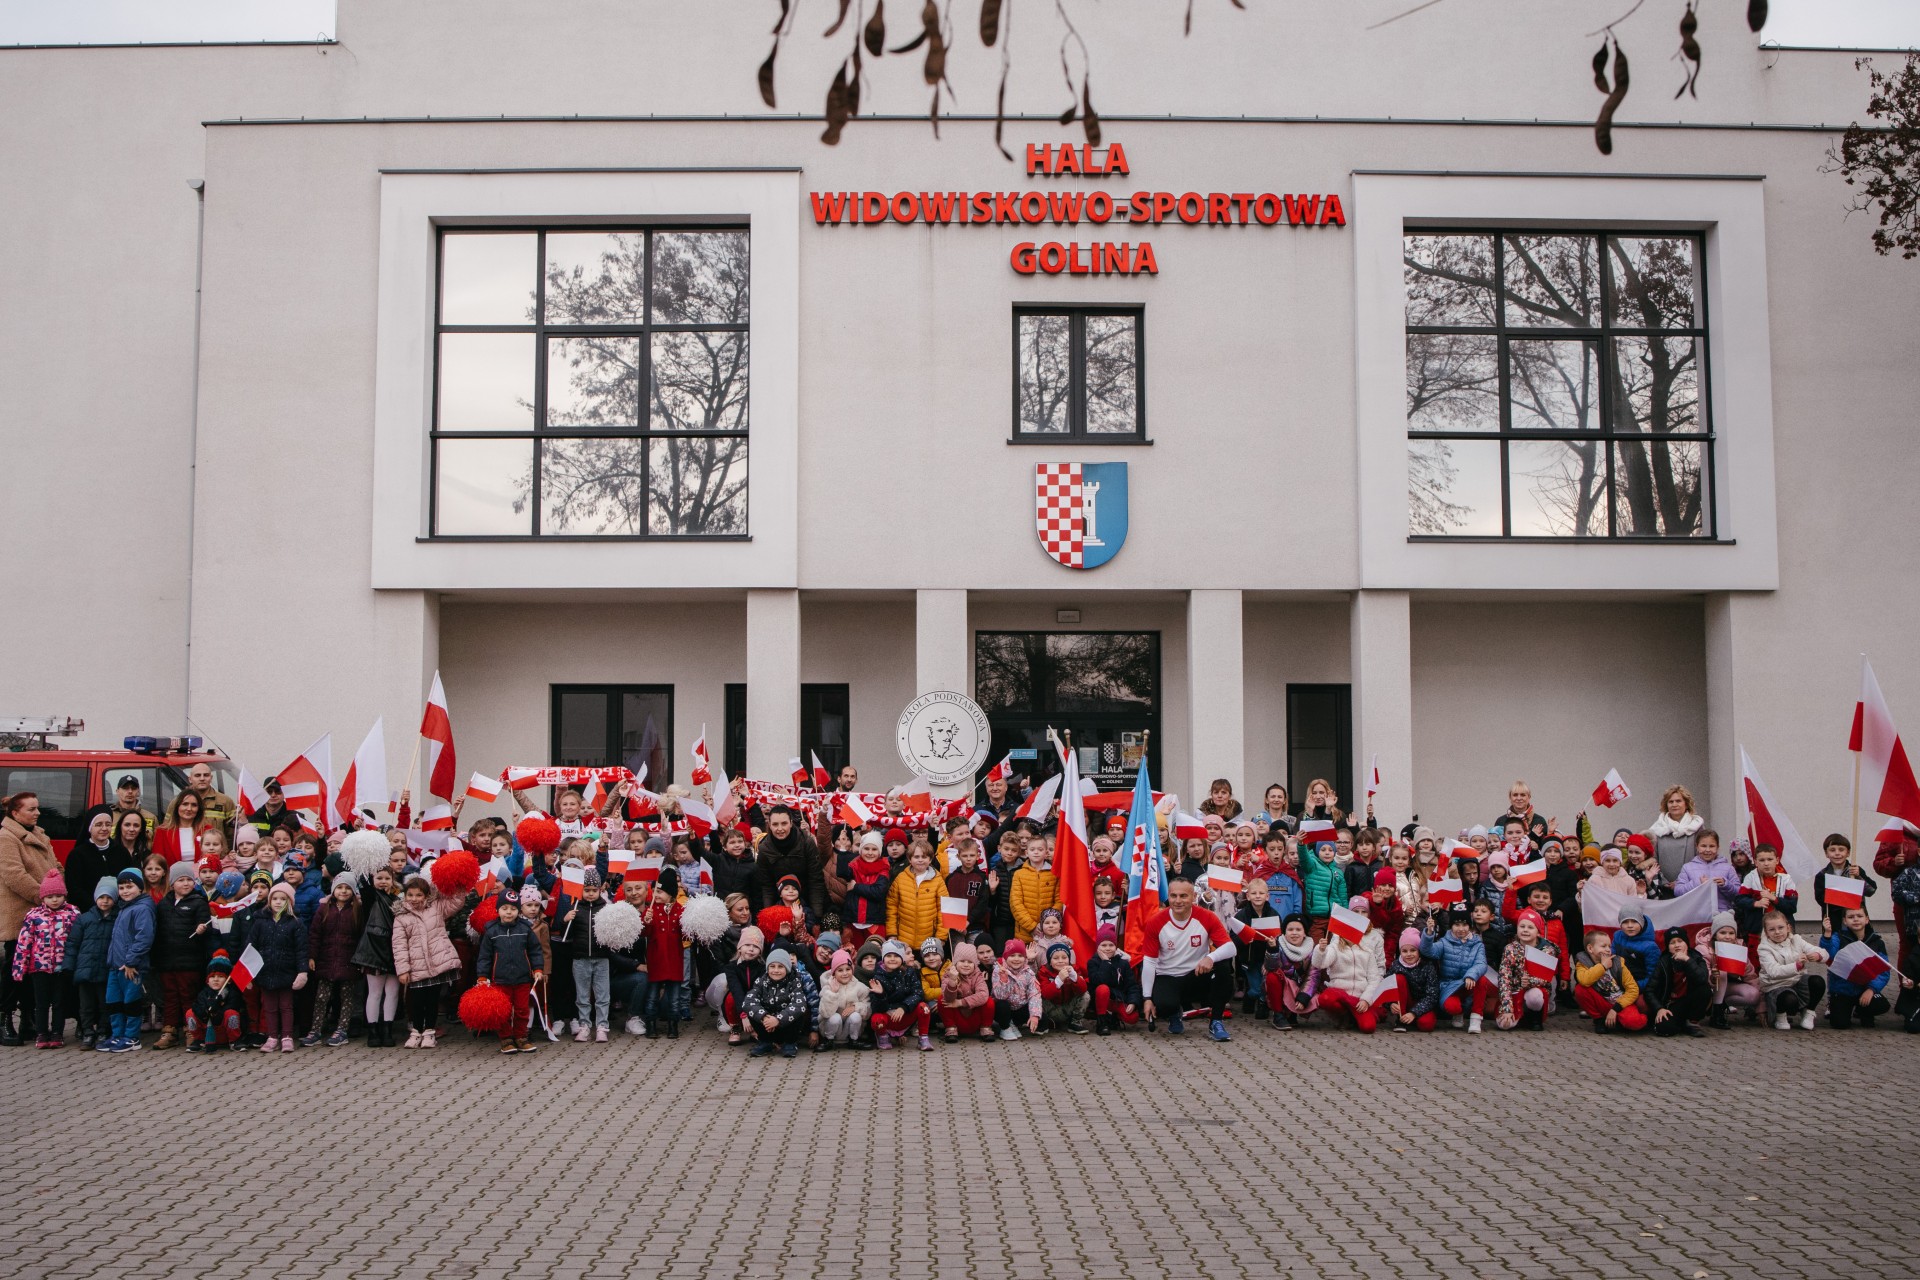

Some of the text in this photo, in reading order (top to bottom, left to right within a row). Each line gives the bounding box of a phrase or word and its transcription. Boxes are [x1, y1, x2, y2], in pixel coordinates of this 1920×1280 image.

[1026, 143, 1130, 175] HALA
[810, 191, 1346, 226] WIDOWISKOWO-SPORTOWA
[1010, 242, 1158, 274] GOLINA
[934, 693, 986, 732] PODSTAWOWA
[967, 881, 981, 896] H
